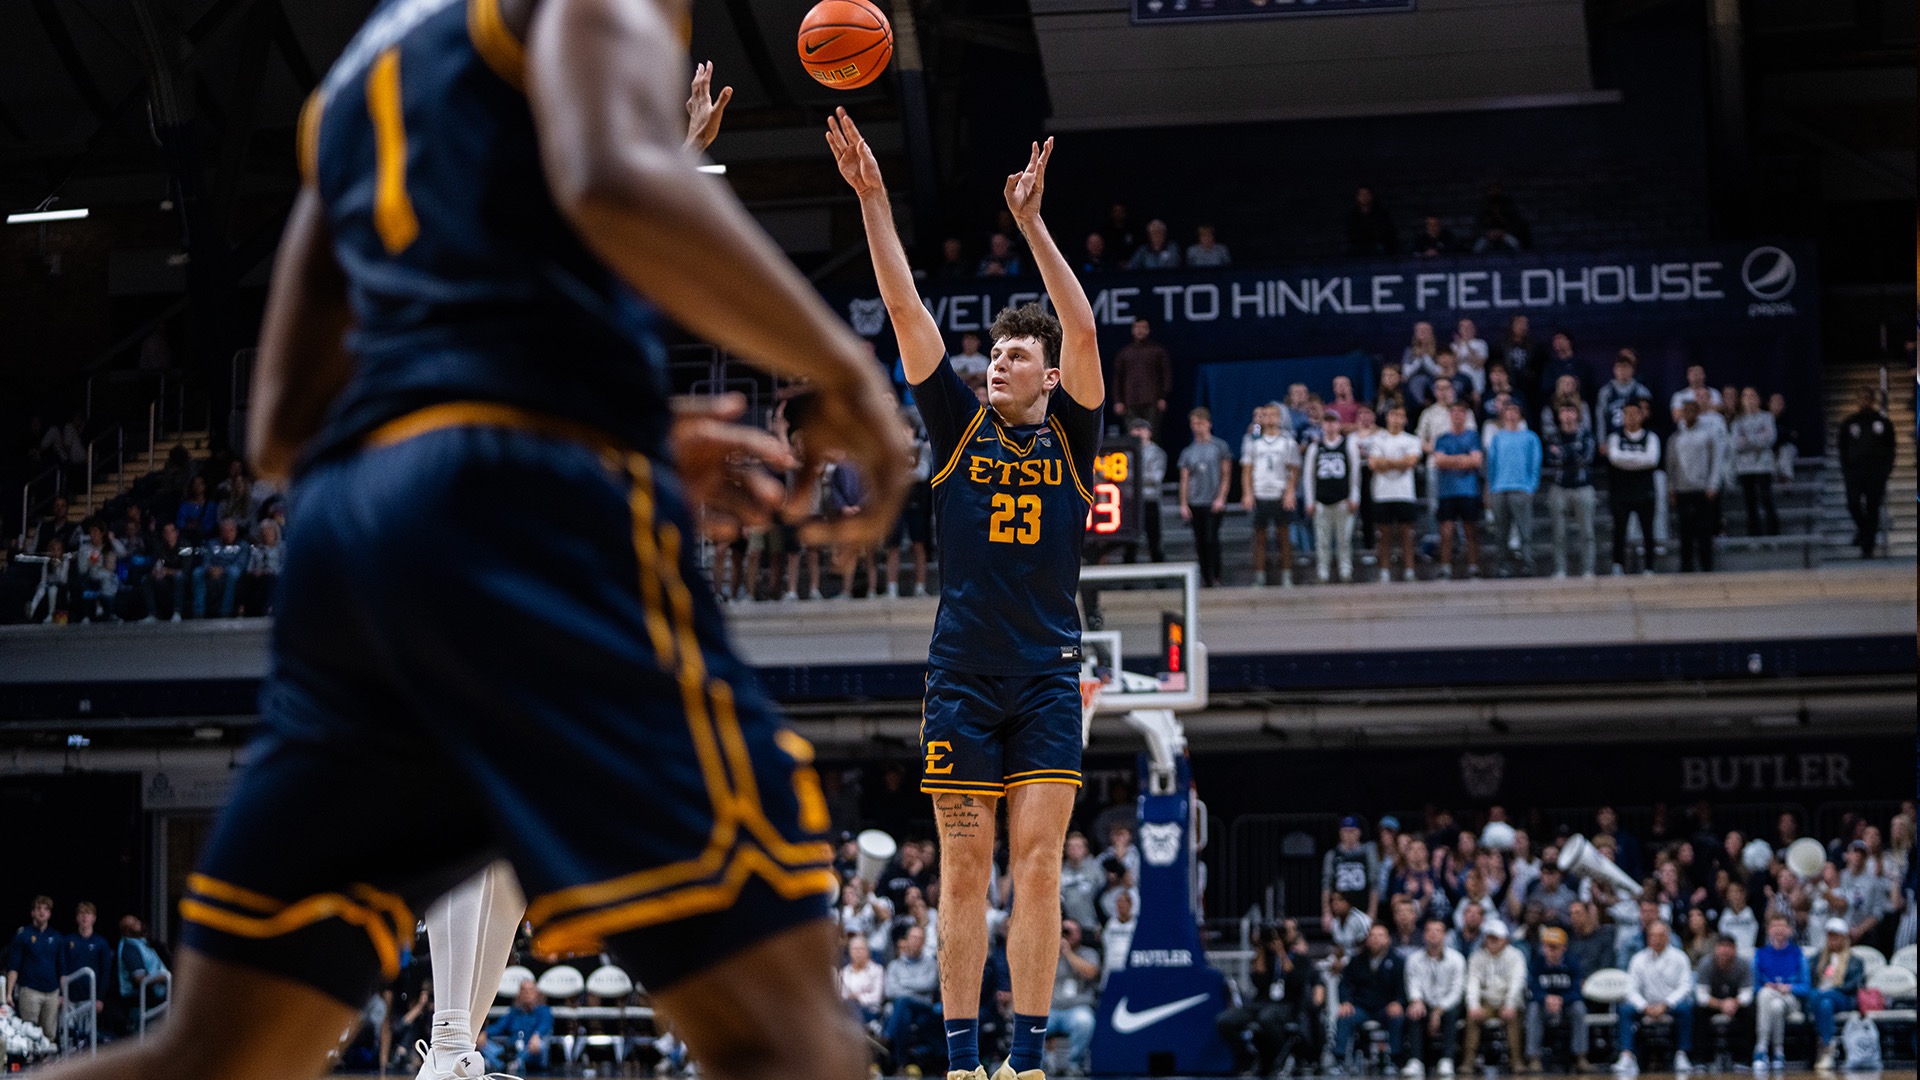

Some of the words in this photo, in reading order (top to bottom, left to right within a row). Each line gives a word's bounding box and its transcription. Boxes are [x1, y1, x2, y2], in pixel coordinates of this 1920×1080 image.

[1153, 283, 1220, 322] TO
[1231, 273, 1405, 319] HINKLE
[1416, 261, 1725, 311] FIELDHOUSE
[969, 455, 1062, 486] ETSU
[1318, 459, 1346, 479] 20
[989, 492, 1042, 545] 23
[1086, 483, 1121, 534] 3
[925, 740, 954, 775] E
[1681, 752, 1854, 792] BUTLER
[1130, 949, 1193, 968] BUTLER
